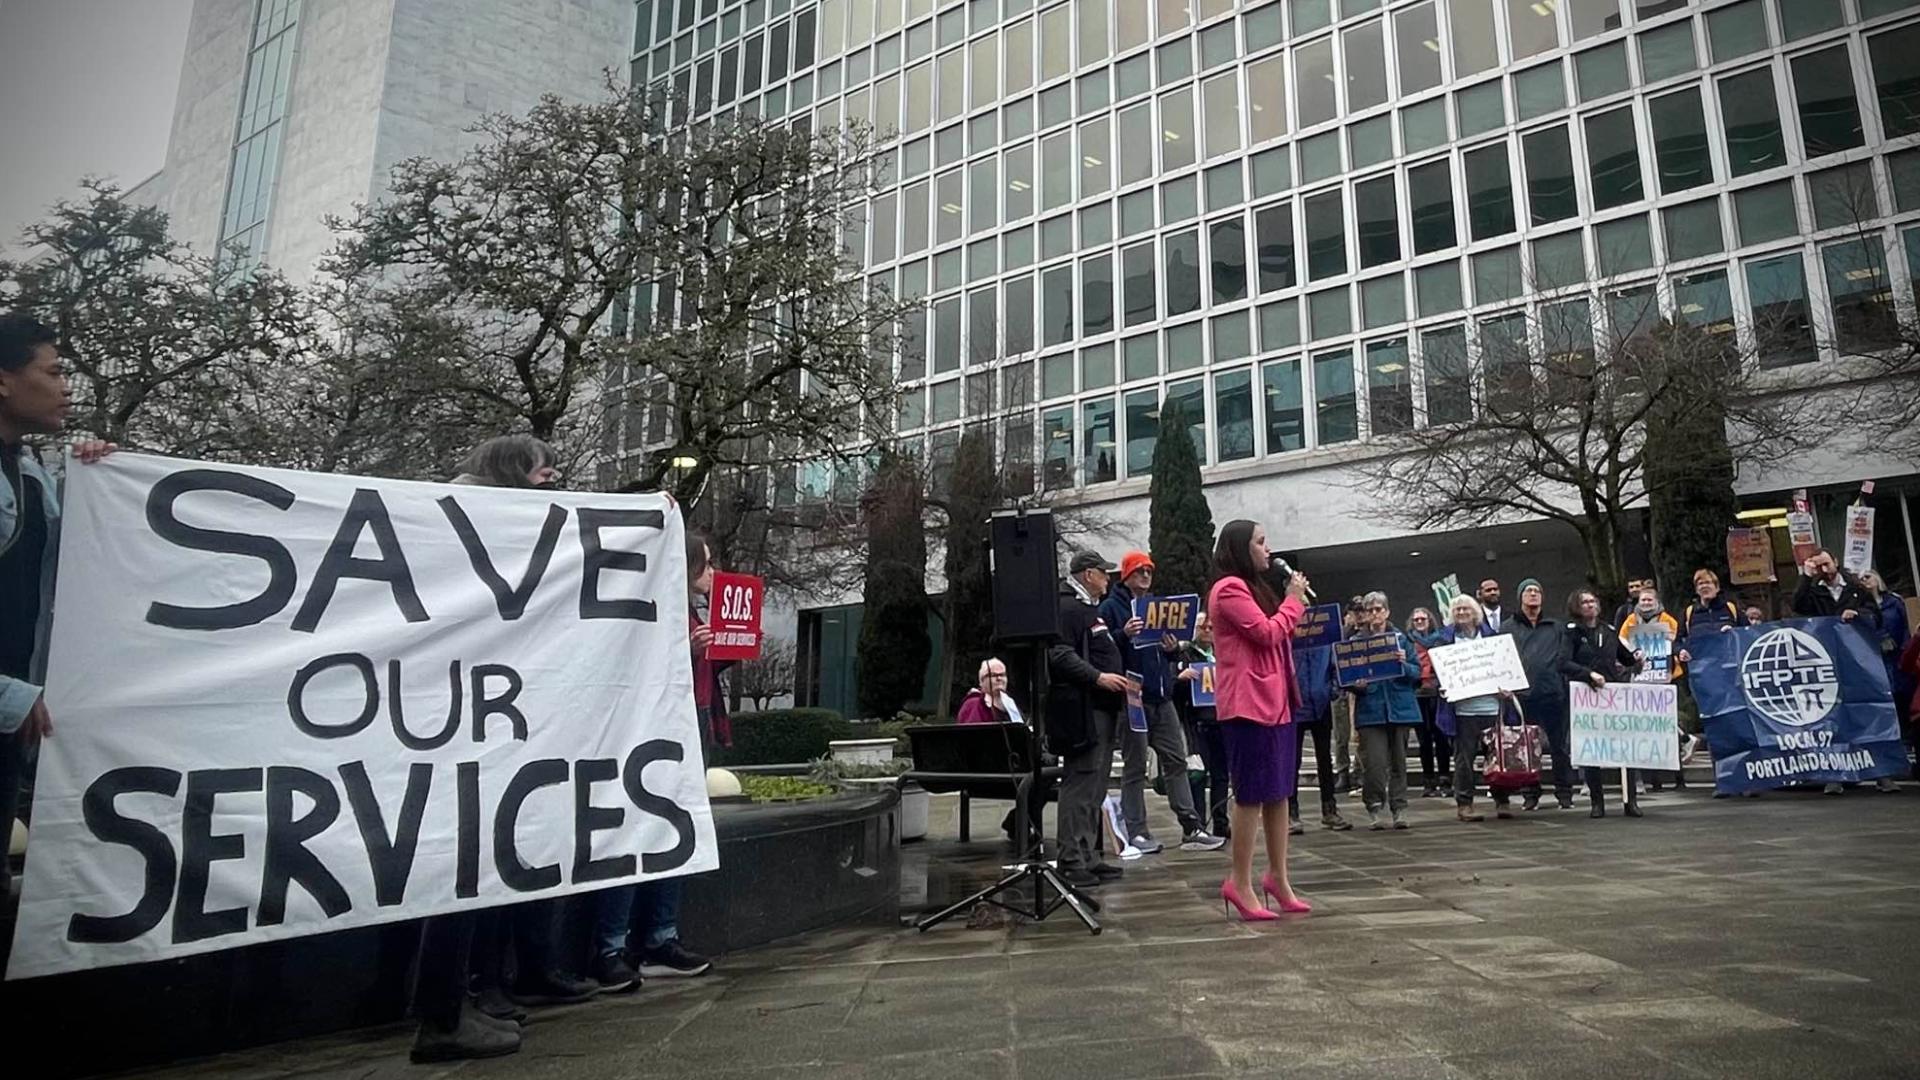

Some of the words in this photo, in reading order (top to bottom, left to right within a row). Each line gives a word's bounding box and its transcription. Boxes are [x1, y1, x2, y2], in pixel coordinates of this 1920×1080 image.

[145, 468, 664, 633] SAVE
[721, 584, 753, 621] S.O.S.
[1145, 601, 1190, 630] AFGE
[1743, 666, 1837, 690] IFPTE
[288, 652, 528, 750] OUR
[1573, 686, 1675, 713] MUSK-TRUMP
[1573, 714, 1600, 731] ARE
[1581, 736, 1670, 764] AMERICA!
[1776, 731, 1818, 751] LOCAL
[1818, 730, 1833, 748] 97
[67, 739, 696, 943] SERVICES
